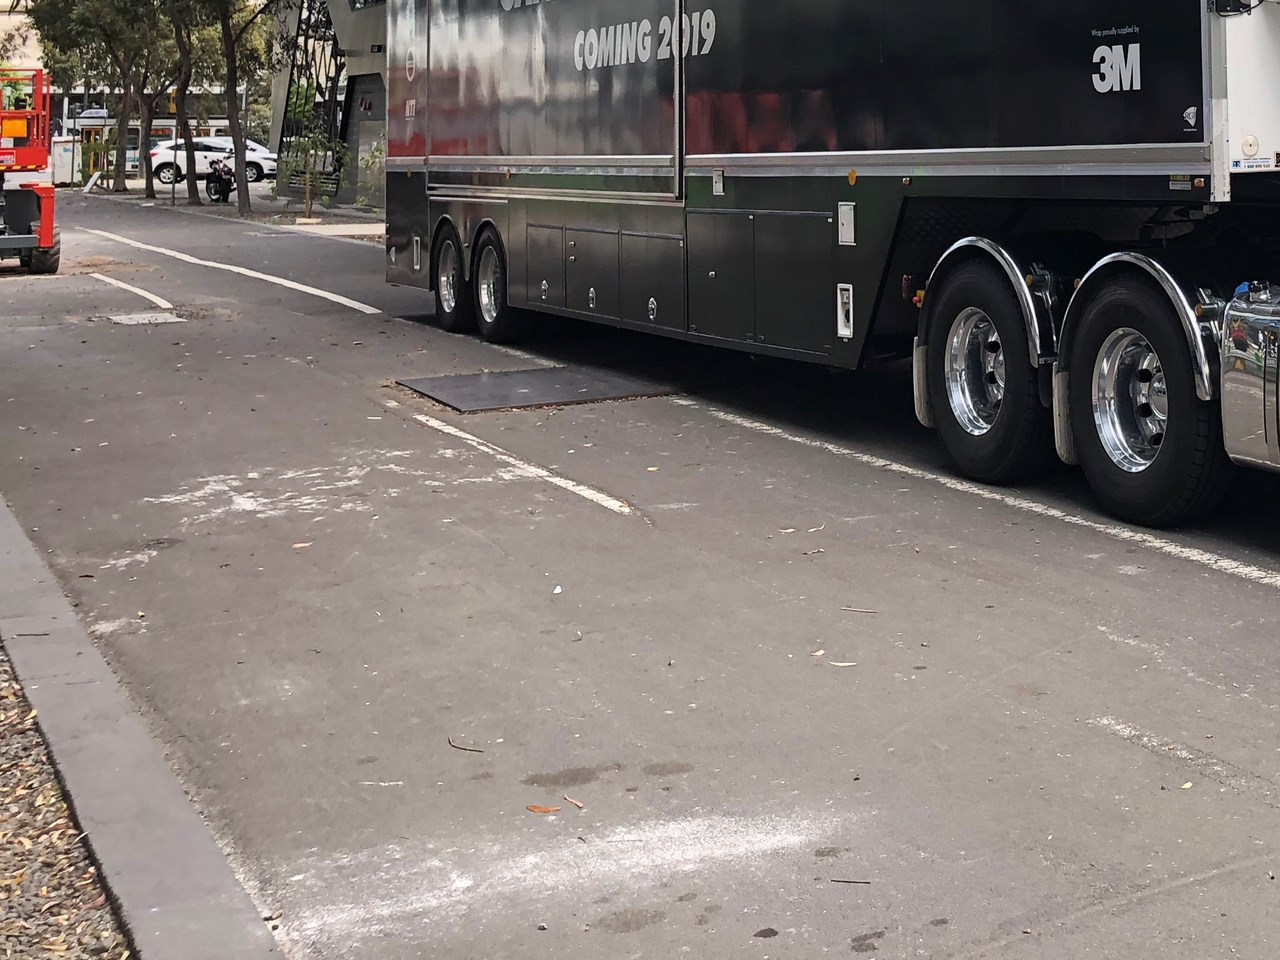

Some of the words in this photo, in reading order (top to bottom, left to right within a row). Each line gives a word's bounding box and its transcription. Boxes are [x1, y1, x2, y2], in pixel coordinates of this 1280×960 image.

[573, 14, 652, 71] COMING
[657, 8, 717, 60] 2019
[1092, 43, 1141, 93] 3M
